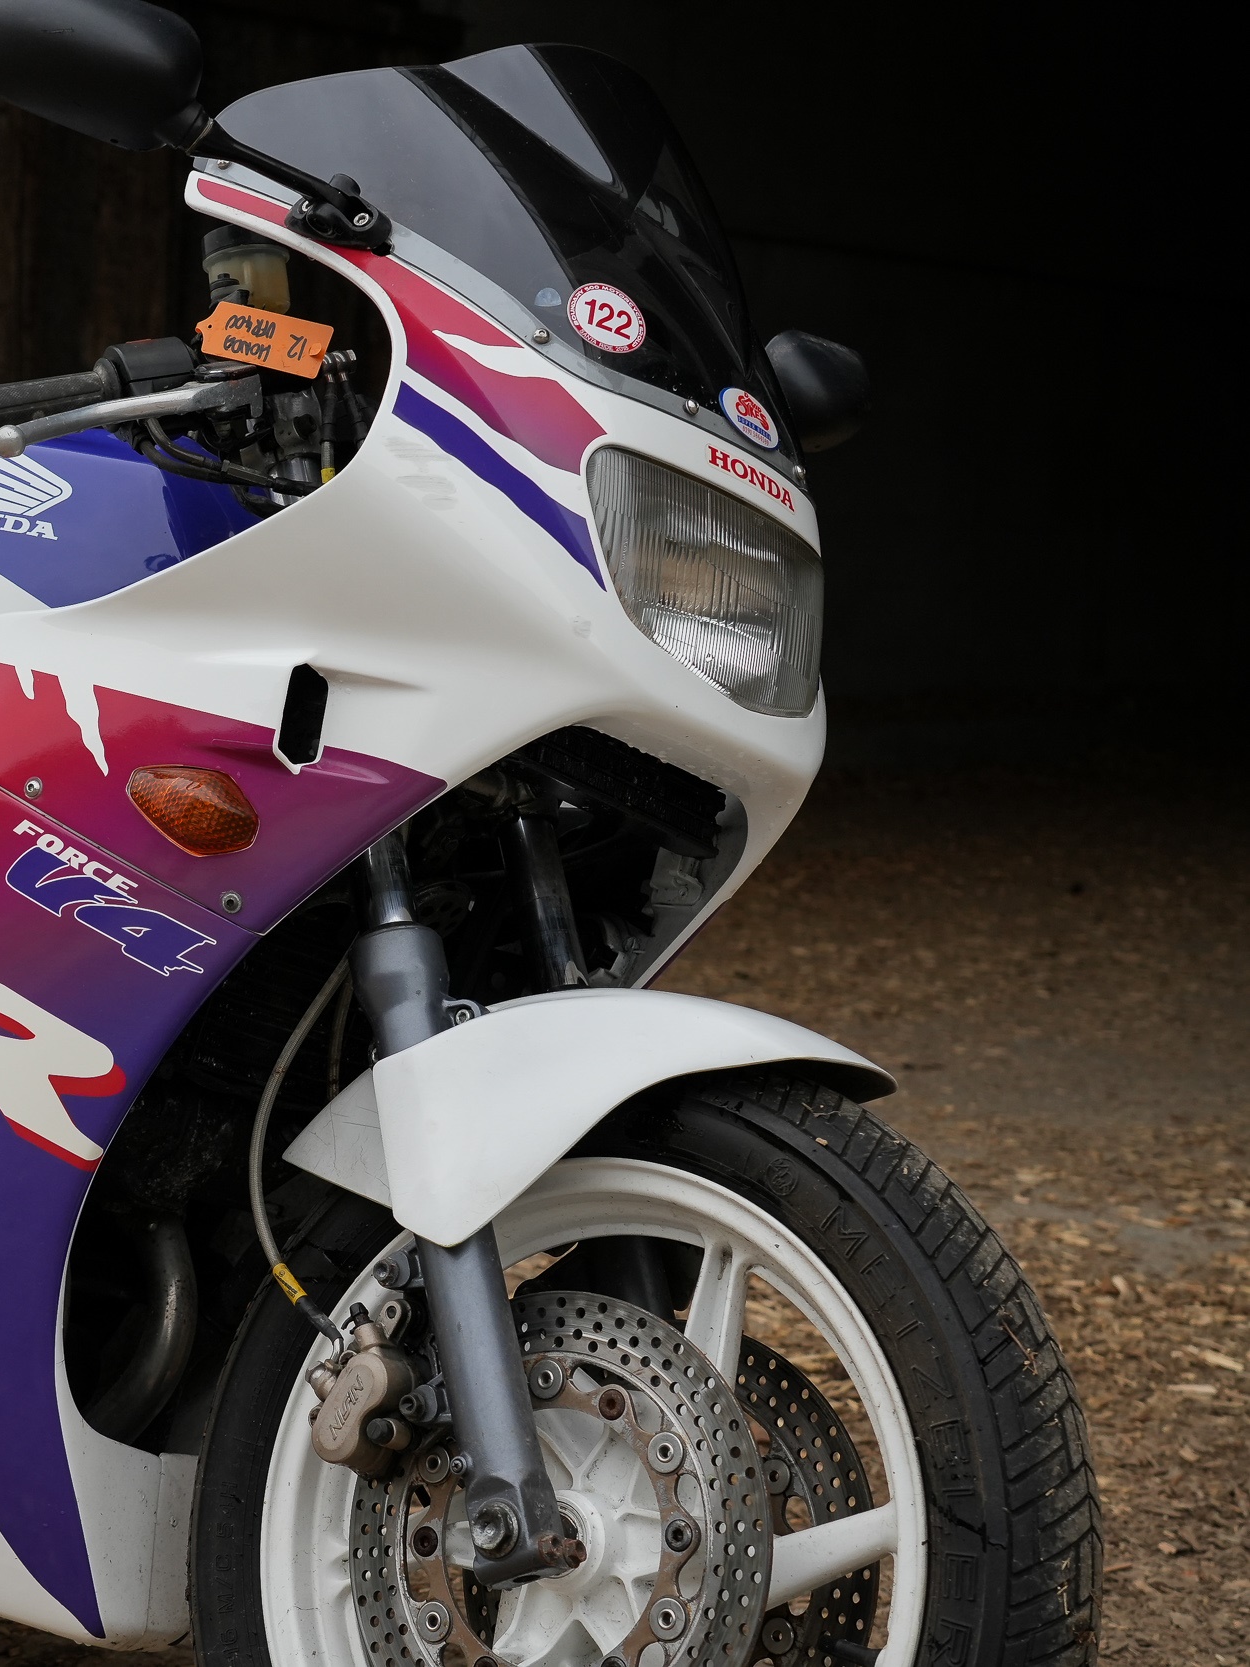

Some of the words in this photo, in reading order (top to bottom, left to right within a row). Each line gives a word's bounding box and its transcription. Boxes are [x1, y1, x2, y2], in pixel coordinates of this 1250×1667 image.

[584, 298, 633, 340] 122
[601, 285, 643, 325] MOTORCYCLE
[286, 333, 308, 361] 12
[579, 329, 598, 346] SANTA
[707, 445, 795, 513] HONDA
[12, 819, 139, 897] FORCE
[5, 845, 217, 976] V4
